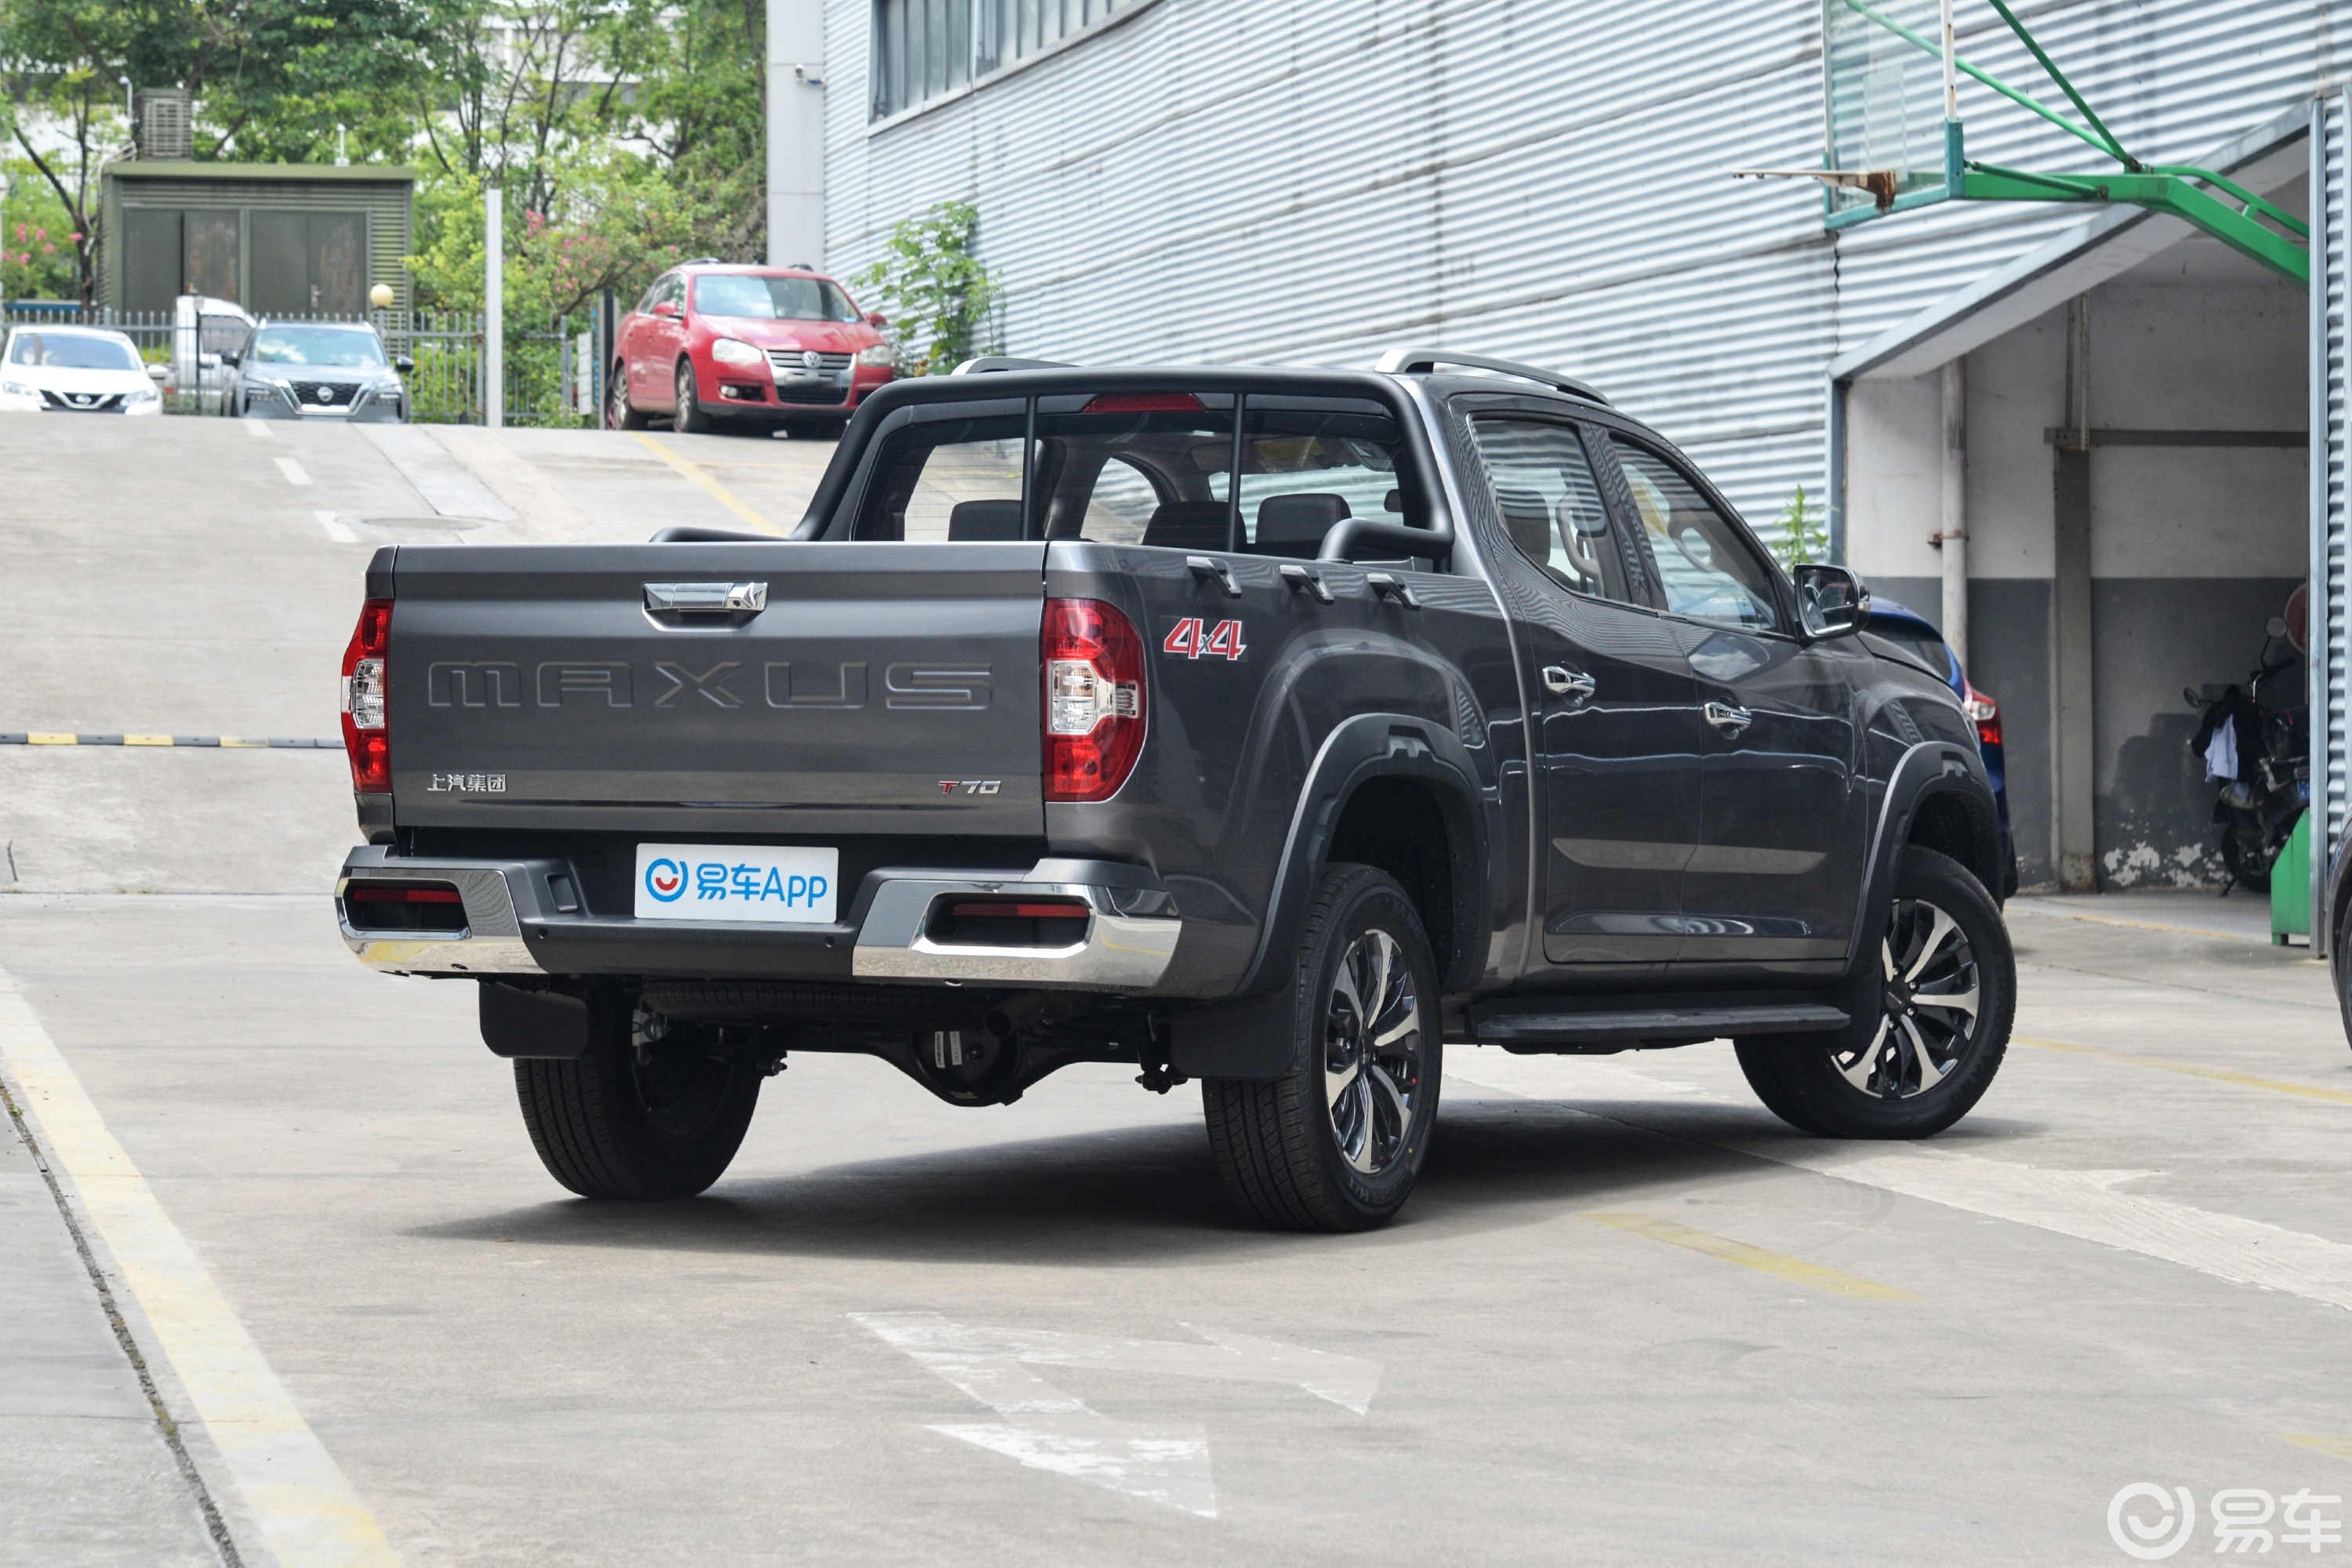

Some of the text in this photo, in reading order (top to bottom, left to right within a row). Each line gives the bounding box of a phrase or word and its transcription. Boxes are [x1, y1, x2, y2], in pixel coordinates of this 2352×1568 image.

[1163, 618, 1247, 661] 4x4
[428, 660, 994, 711] MAXUS
[426, 774, 506, 792] 上汽集团
[696, 862, 828, 908] 易车App
